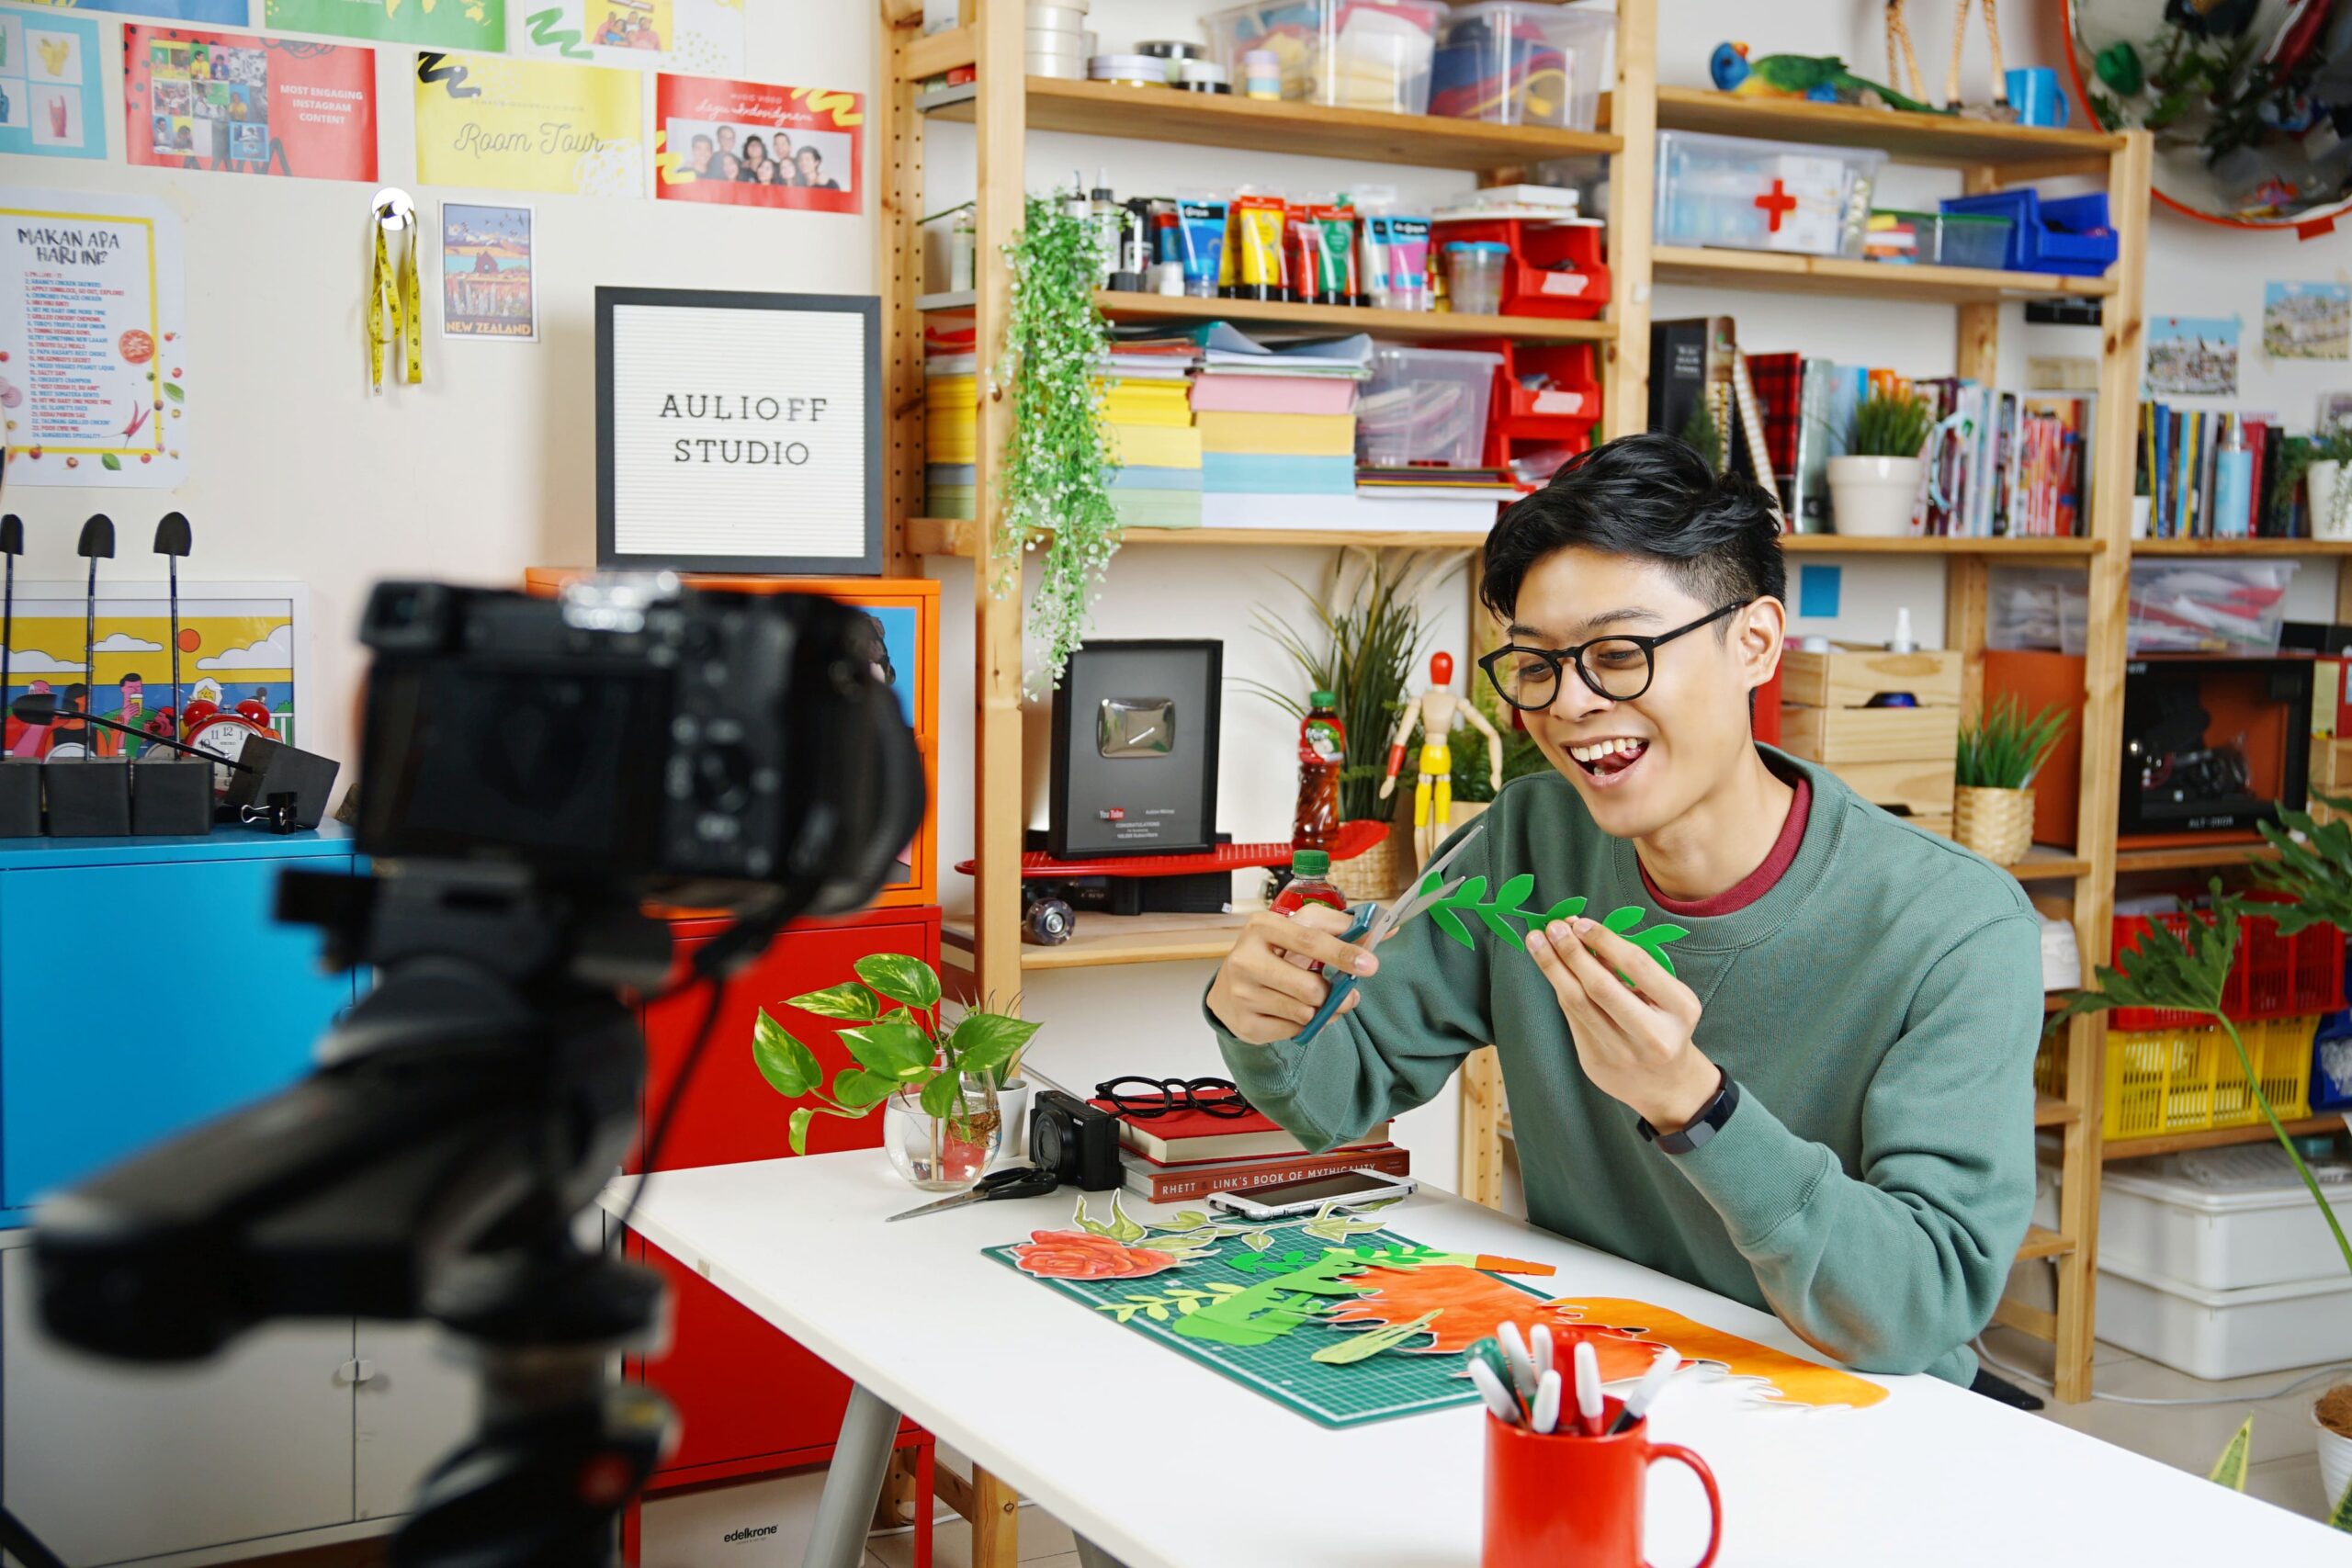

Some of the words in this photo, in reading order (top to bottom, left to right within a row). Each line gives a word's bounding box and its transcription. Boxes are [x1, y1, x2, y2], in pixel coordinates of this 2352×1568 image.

[279, 85, 309, 96] MOST
[310, 87, 363, 101] ENGAGING
[757, 95, 783, 105] VIDEO
[293, 99, 352, 112] INSTAGRAM
[299, 113, 345, 125] CONTENT
[454, 122, 531, 159] Room
[539, 121, 605, 155] Tour
[17, 228, 83, 247] MAKAN
[87, 231, 120, 249] APA
[37, 245, 76, 265] HARI
[81, 248, 109, 265] INI?
[446, 321, 472, 333] NEW
[476, 321, 531, 334] ZEALAND
[659, 394, 828, 422] AULIOFF
[674, 439, 809, 466] STUDIO
[211, 729, 219, 739] 11
[222, 726, 233, 737] 12
[239, 731, 243, 740] 1
[1162, 1183, 1195, 1194] RHETT
[1213, 1177, 1248, 1189] LINK'S
[1253, 1173, 1283, 1185] BOOK
[1288, 1171, 1303, 1180] OF
[724, 1526, 777, 1542] edelkrone
